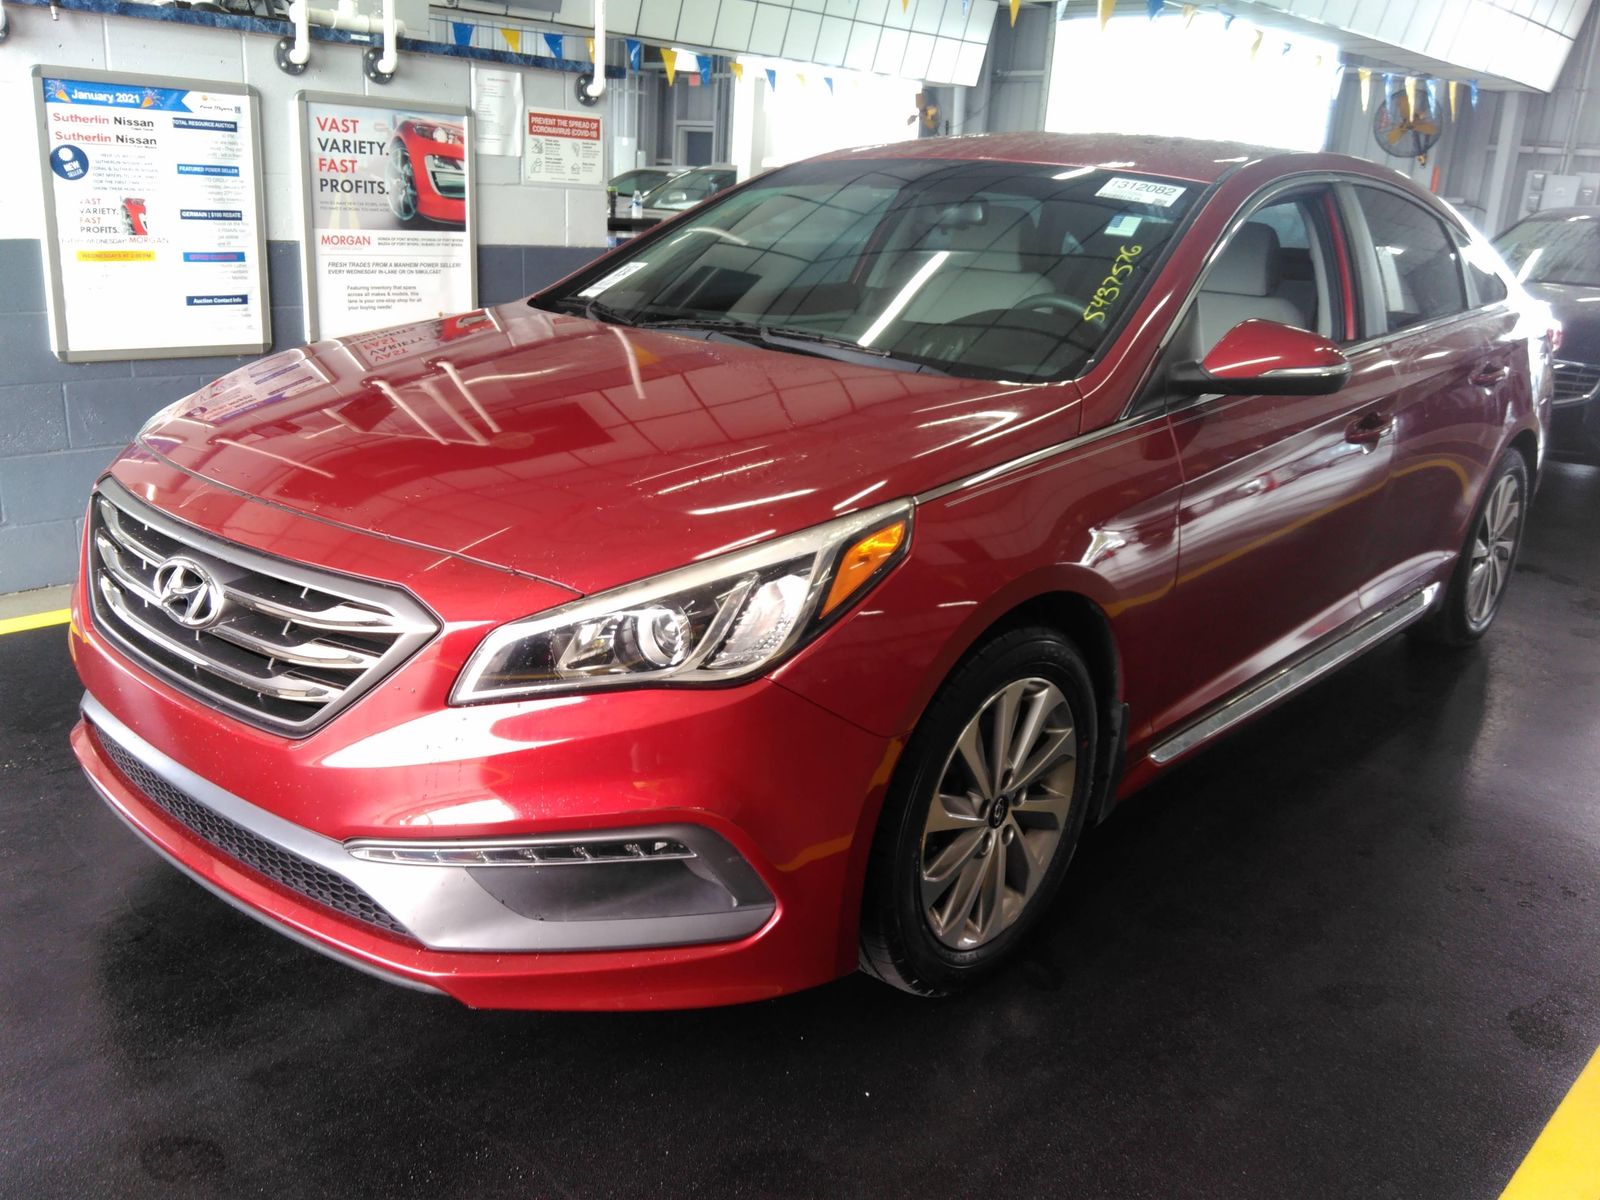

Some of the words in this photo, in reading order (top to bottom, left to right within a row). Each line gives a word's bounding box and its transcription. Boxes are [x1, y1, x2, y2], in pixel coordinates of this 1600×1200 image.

[72, 89, 113, 104] January
[116, 92, 140, 104] 2021
[53, 112, 109, 124] Sutherlin
[114, 116, 154, 127] Nissan
[316, 116, 359, 134] VAST
[530, 116, 556, 126] PREVENT
[557, 118, 568, 126] THE
[568, 120, 590, 129] SPREAD
[55, 131, 111, 142] Sutherlin
[116, 135, 157, 145] Nissan
[532, 126, 570, 135] CORONAVIRUS
[317, 138, 389, 156] VARIETY.
[318, 158, 357, 173] FAST
[320, 178, 389, 195] PROFITS.
[1111, 180, 1177, 196] 1312082
[321, 235, 371, 245] MORGAN
